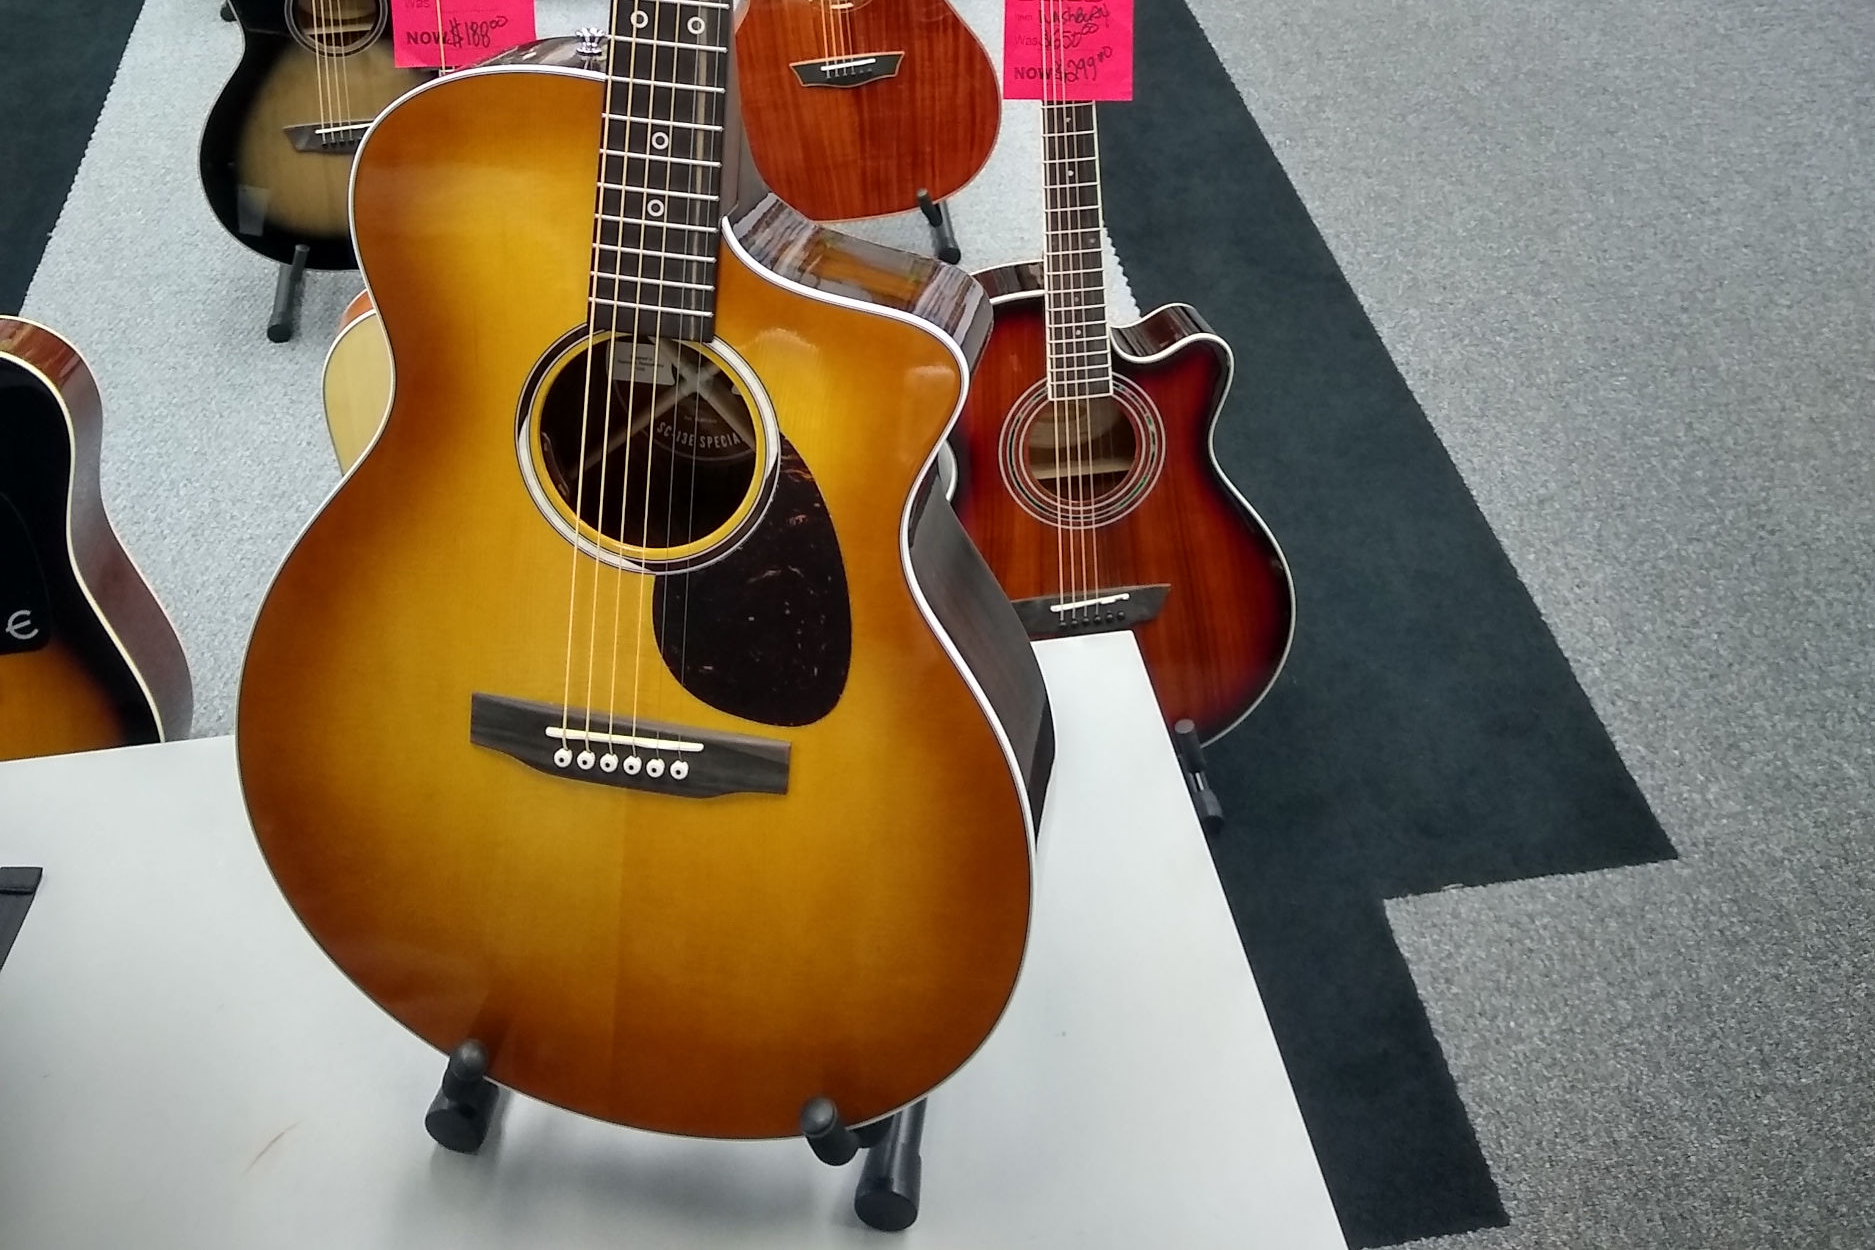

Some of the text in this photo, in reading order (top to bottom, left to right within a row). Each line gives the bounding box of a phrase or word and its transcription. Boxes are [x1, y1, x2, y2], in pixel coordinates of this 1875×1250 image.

[406, 31, 448, 45] NOW
[1014, 67, 1055, 80] NOW
[700, 432, 741, 448] SPECIA
